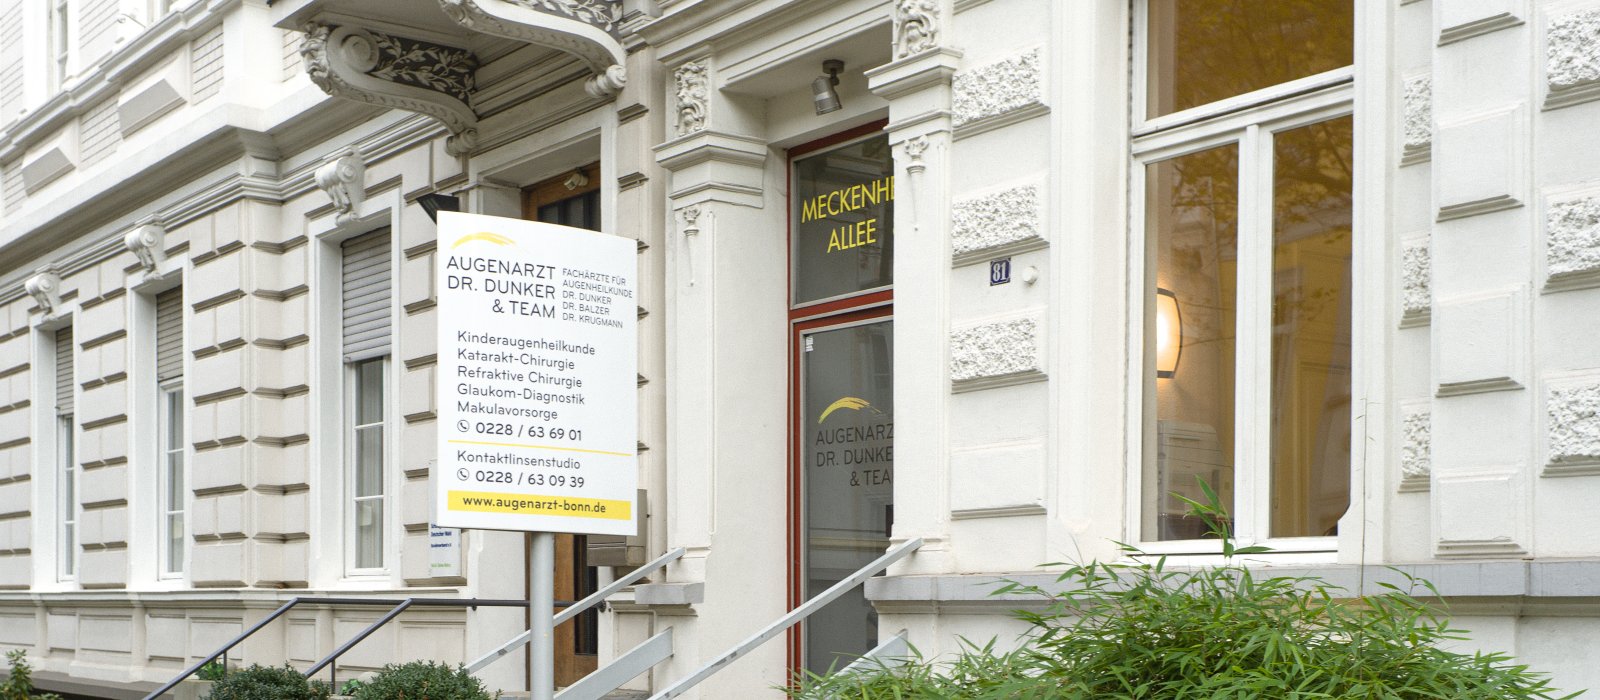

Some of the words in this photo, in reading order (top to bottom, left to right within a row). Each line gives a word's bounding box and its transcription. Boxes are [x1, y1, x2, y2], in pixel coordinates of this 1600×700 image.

[827, 219, 876, 253] ALLEE
[447, 256, 555, 280] AUGENARZT
[563, 268, 609, 283] FACHÄRZTE
[612, 276, 626, 286] FÜR
[992, 262, 1006, 282] 81
[448, 276, 477, 291] DR.
[485, 279, 555, 299] DUNKER
[563, 280, 632, 298] AUGENHEILKUNDE
[563, 291, 577, 300] DR.
[579, 294, 612, 305] DUNKER
[492, 299, 505, 314] &
[509, 301, 555, 319] TEAM
[563, 302, 577, 311] DR.
[579, 305, 609, 315] BALZER
[563, 313, 577, 322] DR.
[579, 315, 623, 329] KRUGMANN
[458, 331, 595, 355] Kinderaugenheilkunde
[458, 349, 575, 371] Katarakt-Chirurgie
[458, 366, 524, 382] Refraktive
[528, 372, 582, 389] Chirurgie
[458, 384, 585, 405] Glaukom-Diagnostik
[458, 402, 558, 421] Makulavorsorge
[476, 422, 513, 436] 0228
[518, 425, 524, 438] /
[528, 426, 544, 438] 63
[549, 428, 564, 439] 69
[569, 430, 582, 441] 01
[816, 424, 893, 445] AUGENARZ
[458, 450, 581, 470] Kontaktlinsenstudio
[817, 451, 839, 467] DR.
[845, 446, 893, 465] DUNKE
[476, 471, 513, 483] 0228
[518, 473, 524, 485] /
[528, 474, 544, 485] 63
[549, 475, 565, 486] 09
[570, 476, 584, 488] 39
[850, 471, 860, 487] &
[864, 469, 891, 486] TEA
[463, 496, 606, 513] www.augenarzt-bonn.de
